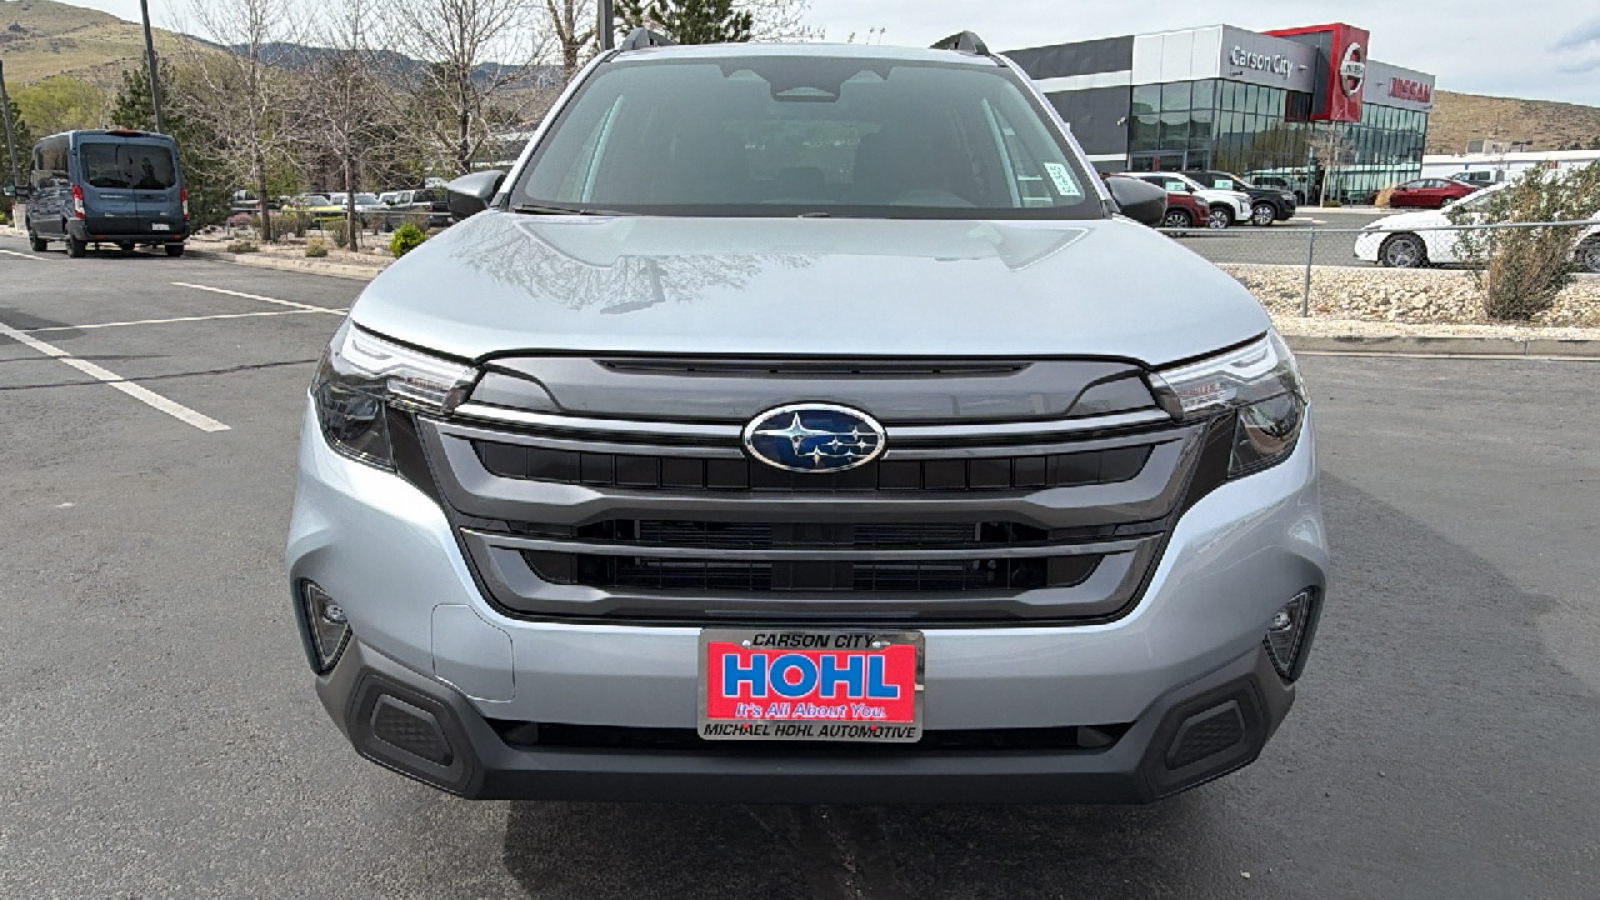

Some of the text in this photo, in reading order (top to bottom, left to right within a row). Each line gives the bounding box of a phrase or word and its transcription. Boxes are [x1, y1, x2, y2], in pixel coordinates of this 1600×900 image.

[1231, 45, 1293, 79] Carson City
[752, 633, 876, 648] CARSON CITY
[722, 653, 900, 699] HOHL
[735, 702, 886, 718] It's All About You.
[703, 723, 916, 738] MICHAEL HOHL AUTOMOTIVE
